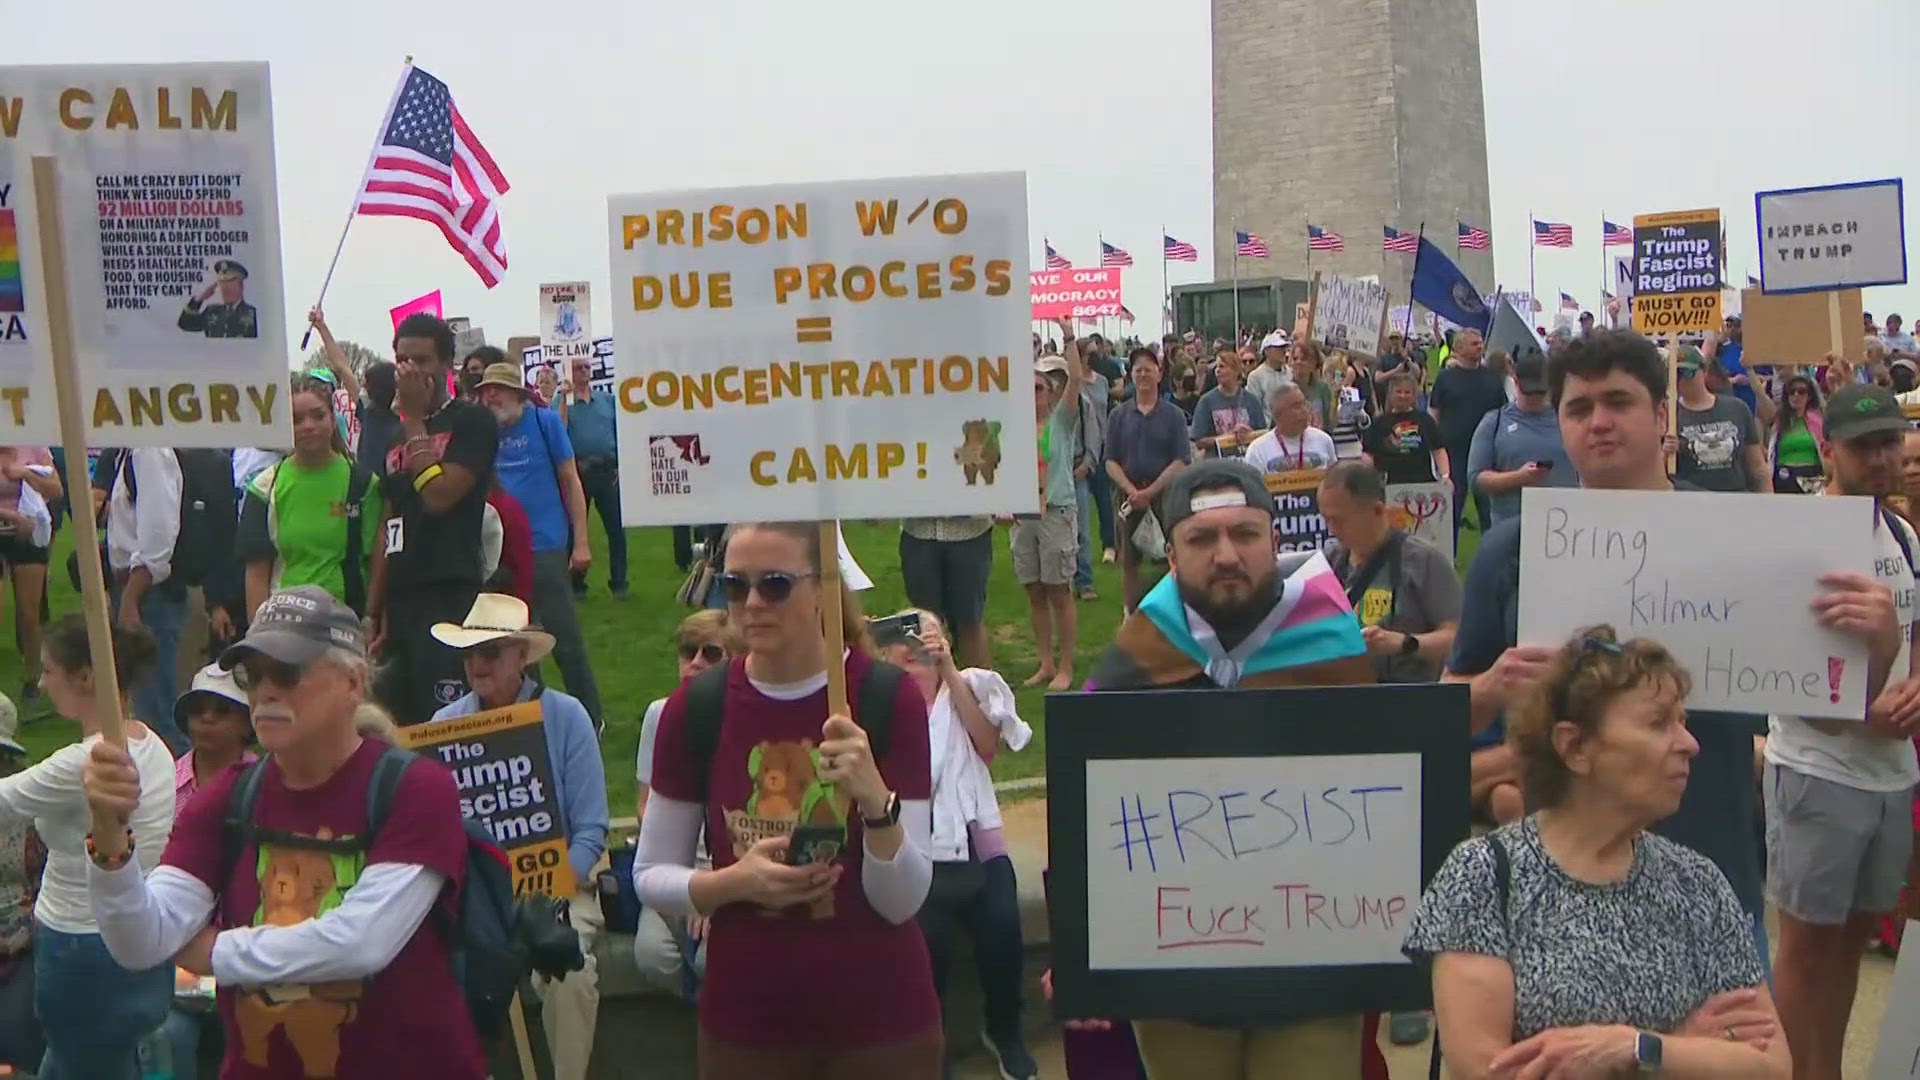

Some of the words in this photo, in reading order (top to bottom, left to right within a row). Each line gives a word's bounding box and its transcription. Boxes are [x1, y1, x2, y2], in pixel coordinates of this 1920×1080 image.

[60, 87, 237, 132] CALM
[96, 175, 122, 188] CALL
[123, 175, 140, 187] ME
[141, 175, 176, 187] CRAZY
[178, 175, 202, 187] BUT
[208, 174, 241, 187] DON'T
[97, 189, 130, 201] THINK
[131, 189, 149, 201] WE
[150, 189, 193, 201] SHOULD
[195, 188, 231, 200] SPEND
[98, 202, 117, 217] 92
[121, 201, 177, 216] MILLION
[180, 200, 244, 216] DOLLARS
[100, 218, 115, 230] ON
[116, 218, 125, 230] A
[126, 218, 175, 230] MILITARY
[178, 217, 220, 230] PARADE
[622, 202, 808, 250] PRISON
[855, 197, 968, 236] W/O
[1767, 221, 1858, 239] IMPEACH
[101, 232, 158, 244] HONORING
[159, 232, 167, 243] A
[169, 231, 202, 243] DRAFT
[205, 231, 249, 243] DODGER
[1661, 227, 1686, 238] The
[102, 245, 134, 257] WHILE
[136, 246, 145, 256] A
[146, 245, 183, 257] SINGLE
[184, 245, 232, 256] VETERAN
[1642, 239, 1710, 256] Trump
[1778, 243, 1852, 261] TRUMP
[103, 259, 136, 271] NEEDS
[138, 258, 209, 271] HEALTHCARE,
[1639, 253, 1714, 273] Fascist
[104, 272, 136, 284] FOOD,
[138, 271, 153, 283] OR
[155, 271, 203, 283] HOUSING
[632, 271, 733, 311] DUE
[773, 254, 1012, 304] PROCESS
[1030, 275, 1061, 286] AVE
[1072, 272, 1109, 283] OUR
[1638, 271, 1716, 292] Regime
[105, 285, 131, 297] THAT
[133, 285, 159, 297] THEY
[161, 285, 193, 297] CAN'T
[1031, 289, 1119, 304] MOCRACY
[106, 298, 150, 310] AFFORD.
[1638, 298, 1684, 312] MUST
[1690, 296, 1716, 308] GO
[1644, 310, 1710, 328] NOW!!!
[543, 345, 564, 357] THE
[566, 343, 590, 356] LAW
[618, 355, 1010, 414] CONCENTRATION
[93, 383, 277, 428] ANGRY
[650, 446, 665, 458] NO
[651, 458, 675, 470] HATE
[750, 442, 928, 487] CAMP!
[652, 471, 663, 483] IN
[666, 469, 688, 482] OUR
[652, 483, 681, 496] STATE
[1274, 493, 1310, 511] The
[1545, 507, 1647, 583] Bring
[1704, 647, 1845, 704] Home!
[438, 742, 485, 762] The
[452, 755, 532, 790] ump
[460, 777, 546, 818] scist
[482, 811, 552, 842] ime
[1110, 787, 1403, 872] #RESIST
[516, 848, 560, 874] GO
